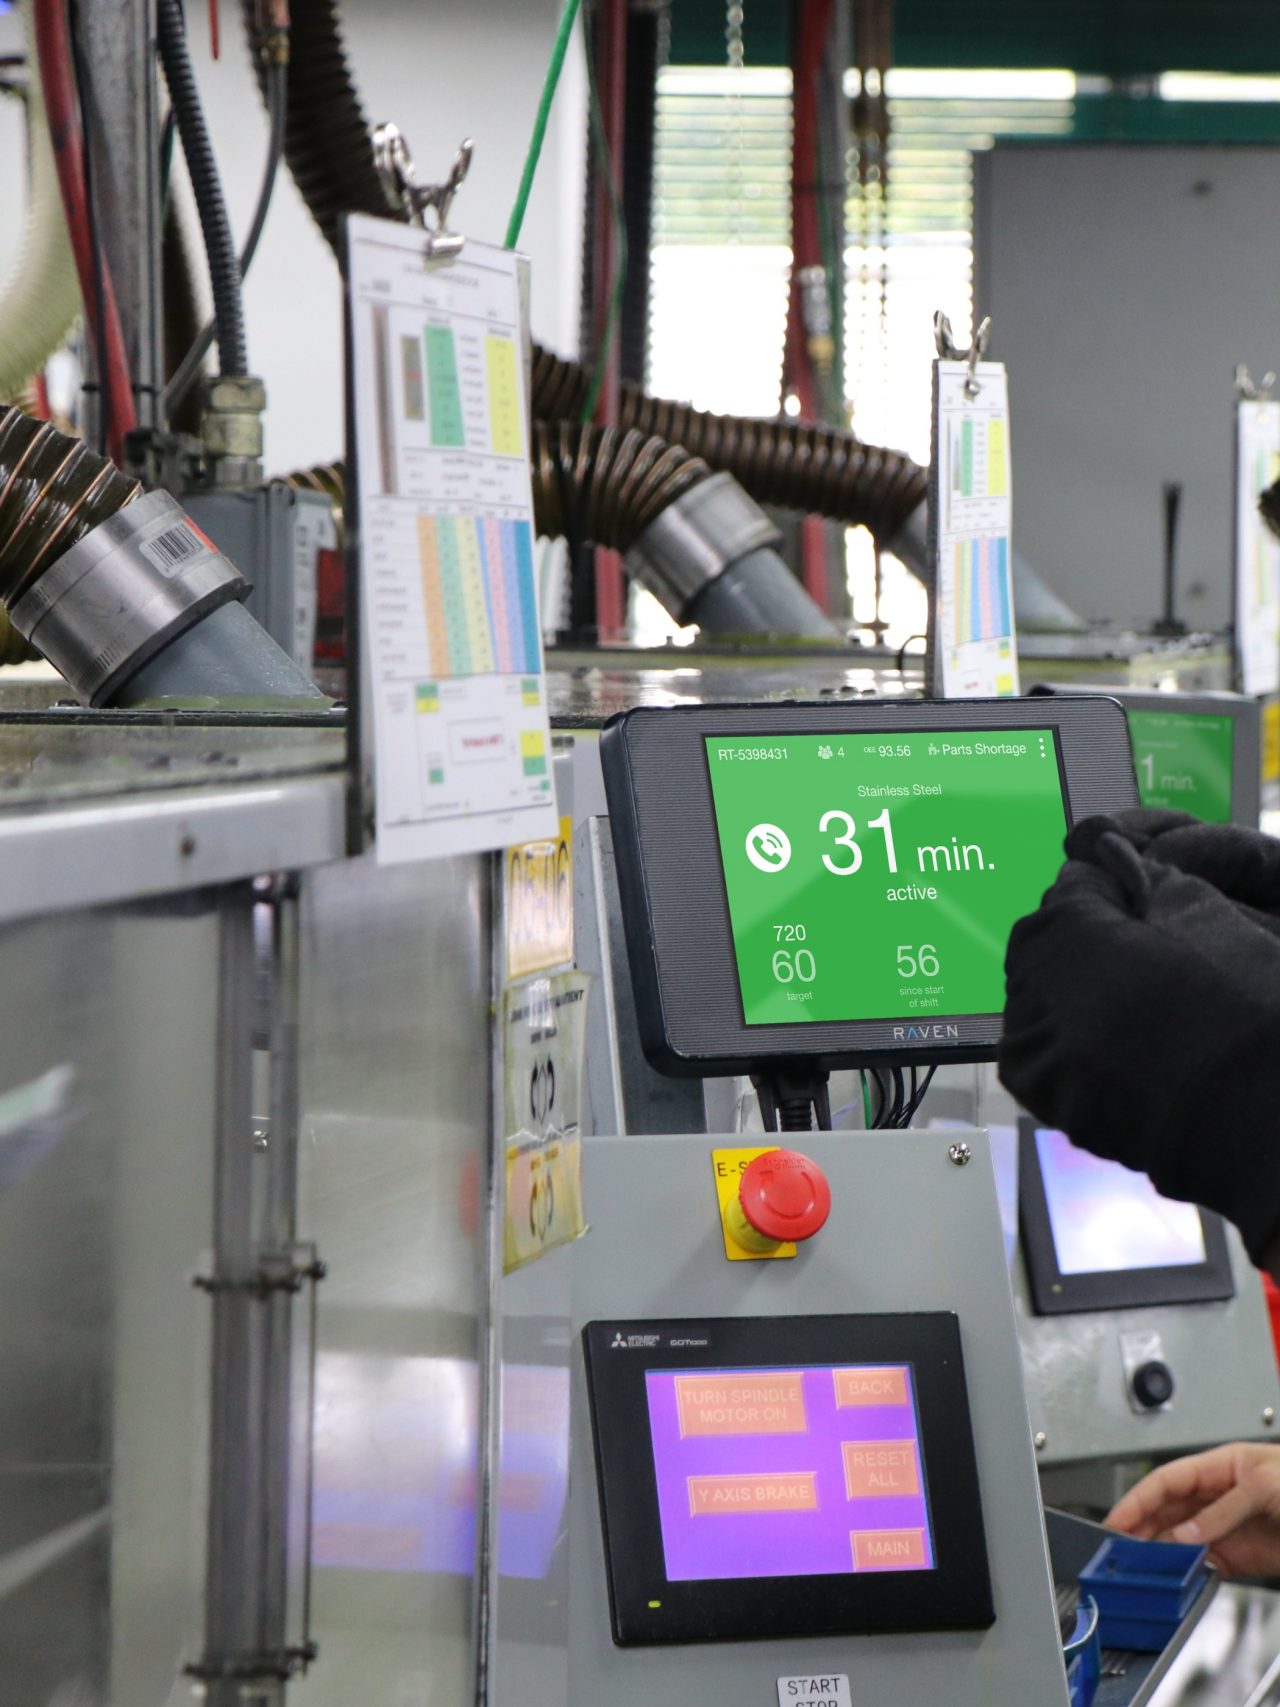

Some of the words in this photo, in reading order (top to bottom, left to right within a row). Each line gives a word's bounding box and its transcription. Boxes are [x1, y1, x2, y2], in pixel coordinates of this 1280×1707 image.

[718, 748, 788, 761] RT-5398431
[837, 747, 845, 757] 4
[879, 745, 911, 757] 93.56
[942, 744, 972, 755] Parts
[975, 743, 1027, 757] Shortage
[857, 785, 909, 797] Stainless
[912, 784, 942, 796] Steel
[819, 808, 898, 876] 31
[917, 837, 995, 872] min.
[886, 884, 938, 901] active
[773, 924, 806, 942] 720
[772, 949, 816, 983] 60
[897, 944, 940, 978] 56
[787, 991, 813, 1001] target
[899, 986, 923, 996] since
[925, 985, 945, 995] start
[909, 999, 918, 1008] of
[920, 998, 939, 1008] shift
[717, 1161, 752, 1177] E-S
[684, 1390, 726, 1405] TURN
[731, 1387, 799, 1402] SPINDLE
[849, 1380, 895, 1395] BACK
[700, 1408, 758, 1423] MOTOR
[763, 1406, 787, 1420] ON
[854, 1450, 908, 1466] RESET
[868, 1472, 898, 1487] ALL
[699, 1488, 709, 1503] Y
[713, 1486, 751, 1502] AXIS
[755, 1484, 809, 1500] BRAKE
[867, 1541, 910, 1556] MAIN
[788, 1678, 840, 1695] START
